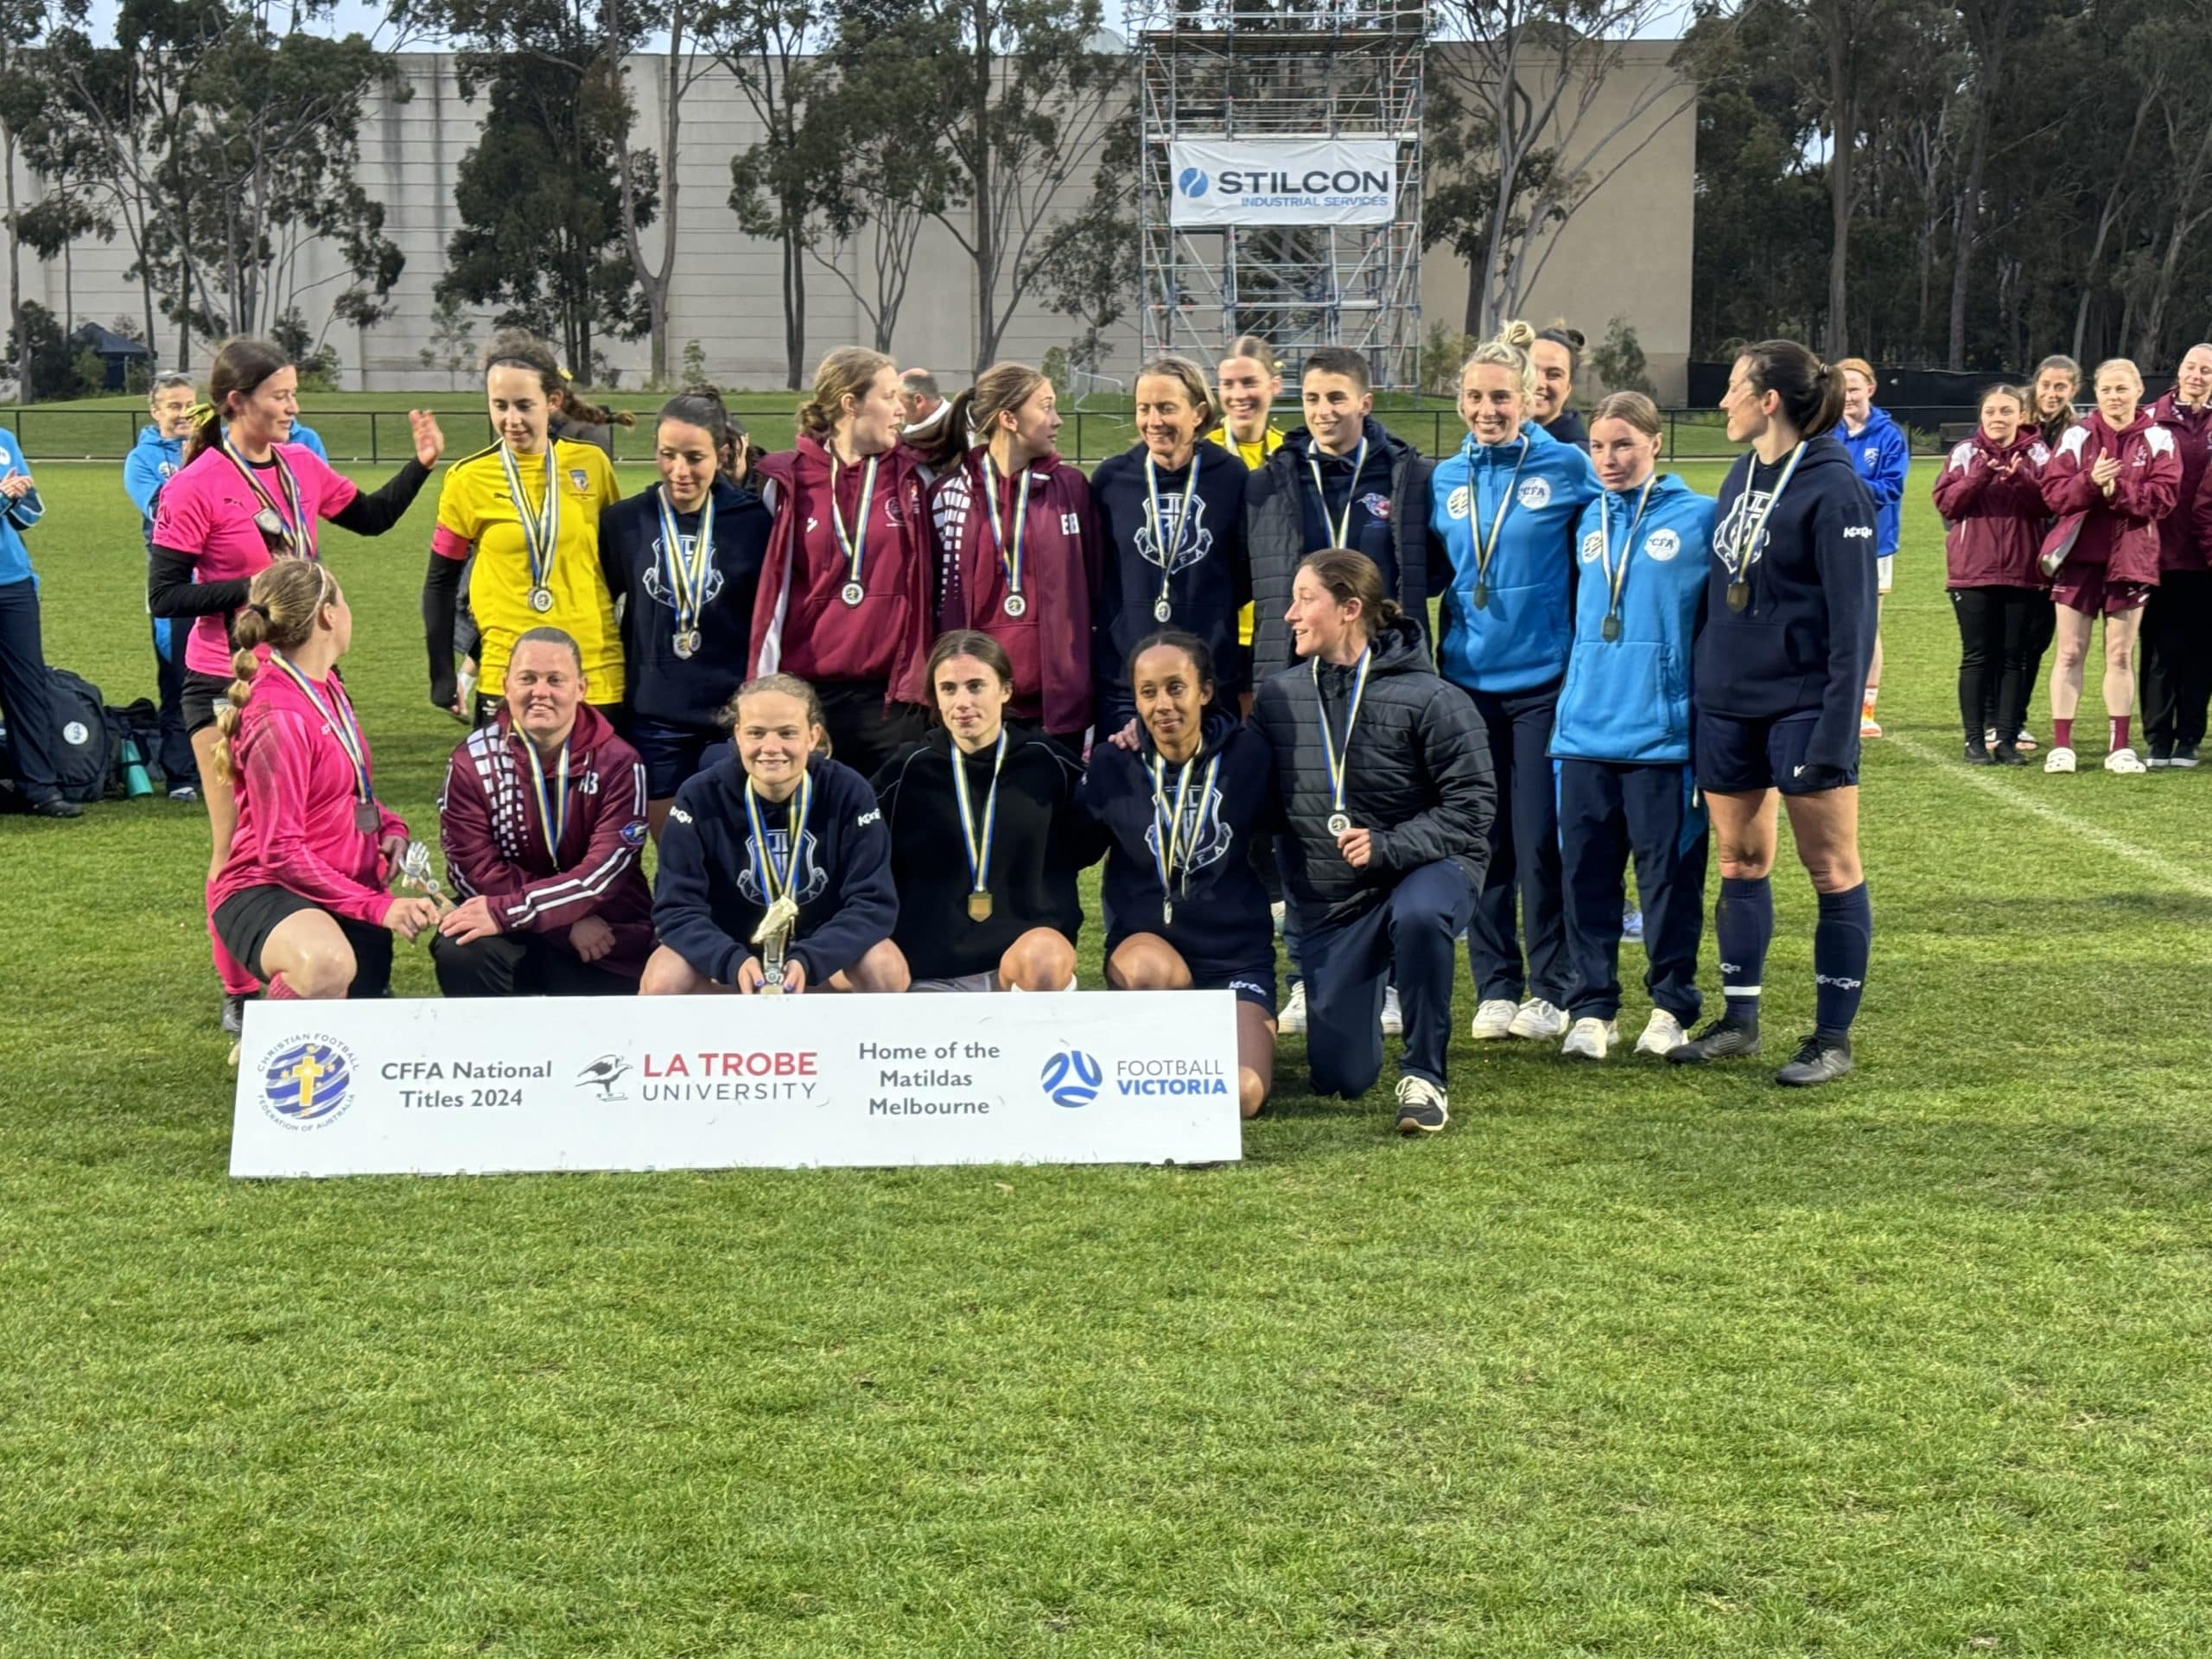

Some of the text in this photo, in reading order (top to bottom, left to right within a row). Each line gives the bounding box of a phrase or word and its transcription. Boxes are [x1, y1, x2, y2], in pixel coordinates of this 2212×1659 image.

[1217, 170, 1388, 194] STILCON
[1241, 196, 1389, 207] INDUSTRIAL SERVICES
[257, 1032, 360, 1072] CHRISTIAN FOOTBALL
[858, 1041, 1001, 1060] Home of the
[381, 1060, 552, 1081] CFFA National
[644, 1052, 818, 1077] LA TROBE
[1116, 1059, 1224, 1077] FOOTBALL
[880, 1068, 973, 1088] Matildas
[1116, 1078, 1229, 1096] VICTORIA
[399, 1089, 524, 1109] Titles 2024
[643, 1082, 817, 1102] UNIVERSITY
[257, 1092, 356, 1133] FEDERATION OF AUSTRALIA
[869, 1096, 990, 1116] Melbourne
